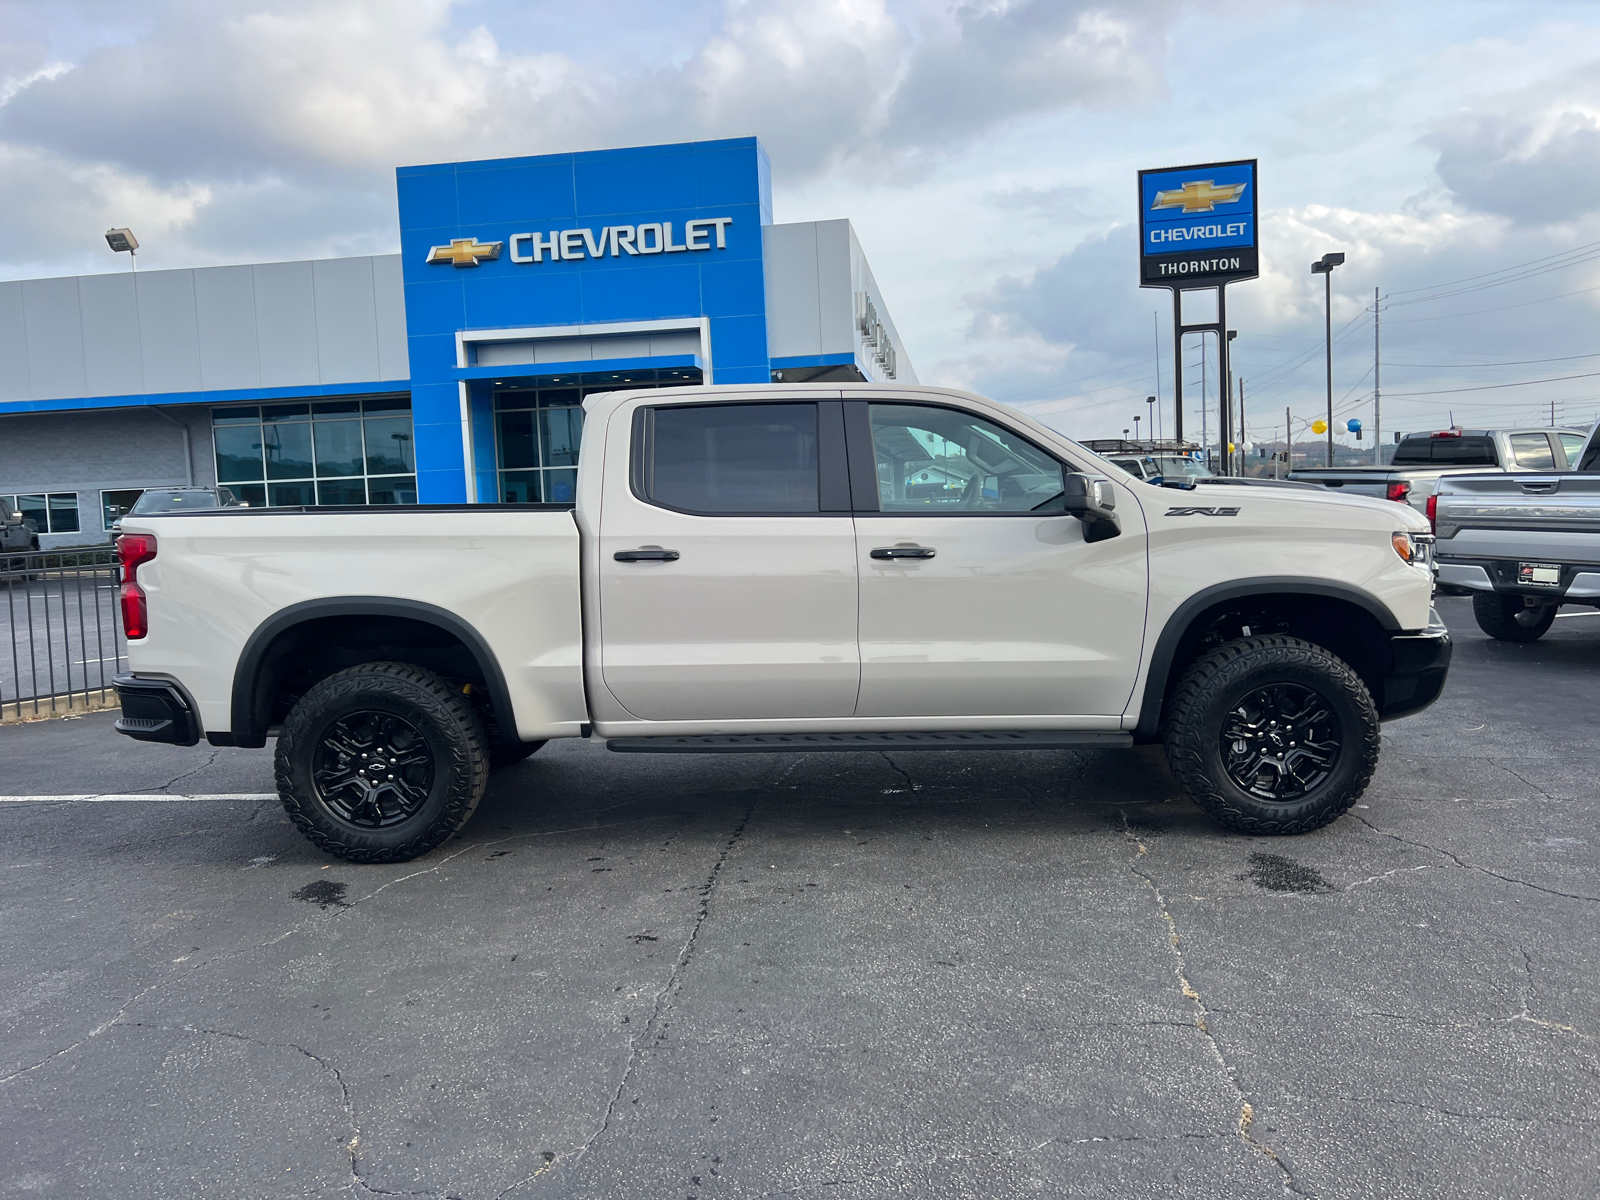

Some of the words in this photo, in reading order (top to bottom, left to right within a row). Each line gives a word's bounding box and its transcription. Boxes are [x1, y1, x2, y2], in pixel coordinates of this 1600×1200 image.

[509, 217, 733, 263] CHEVROLET
[1150, 222, 1247, 243] CHEVROLET
[1159, 257, 1240, 275] THORNTON
[1164, 507, 1242, 516] ZR2
